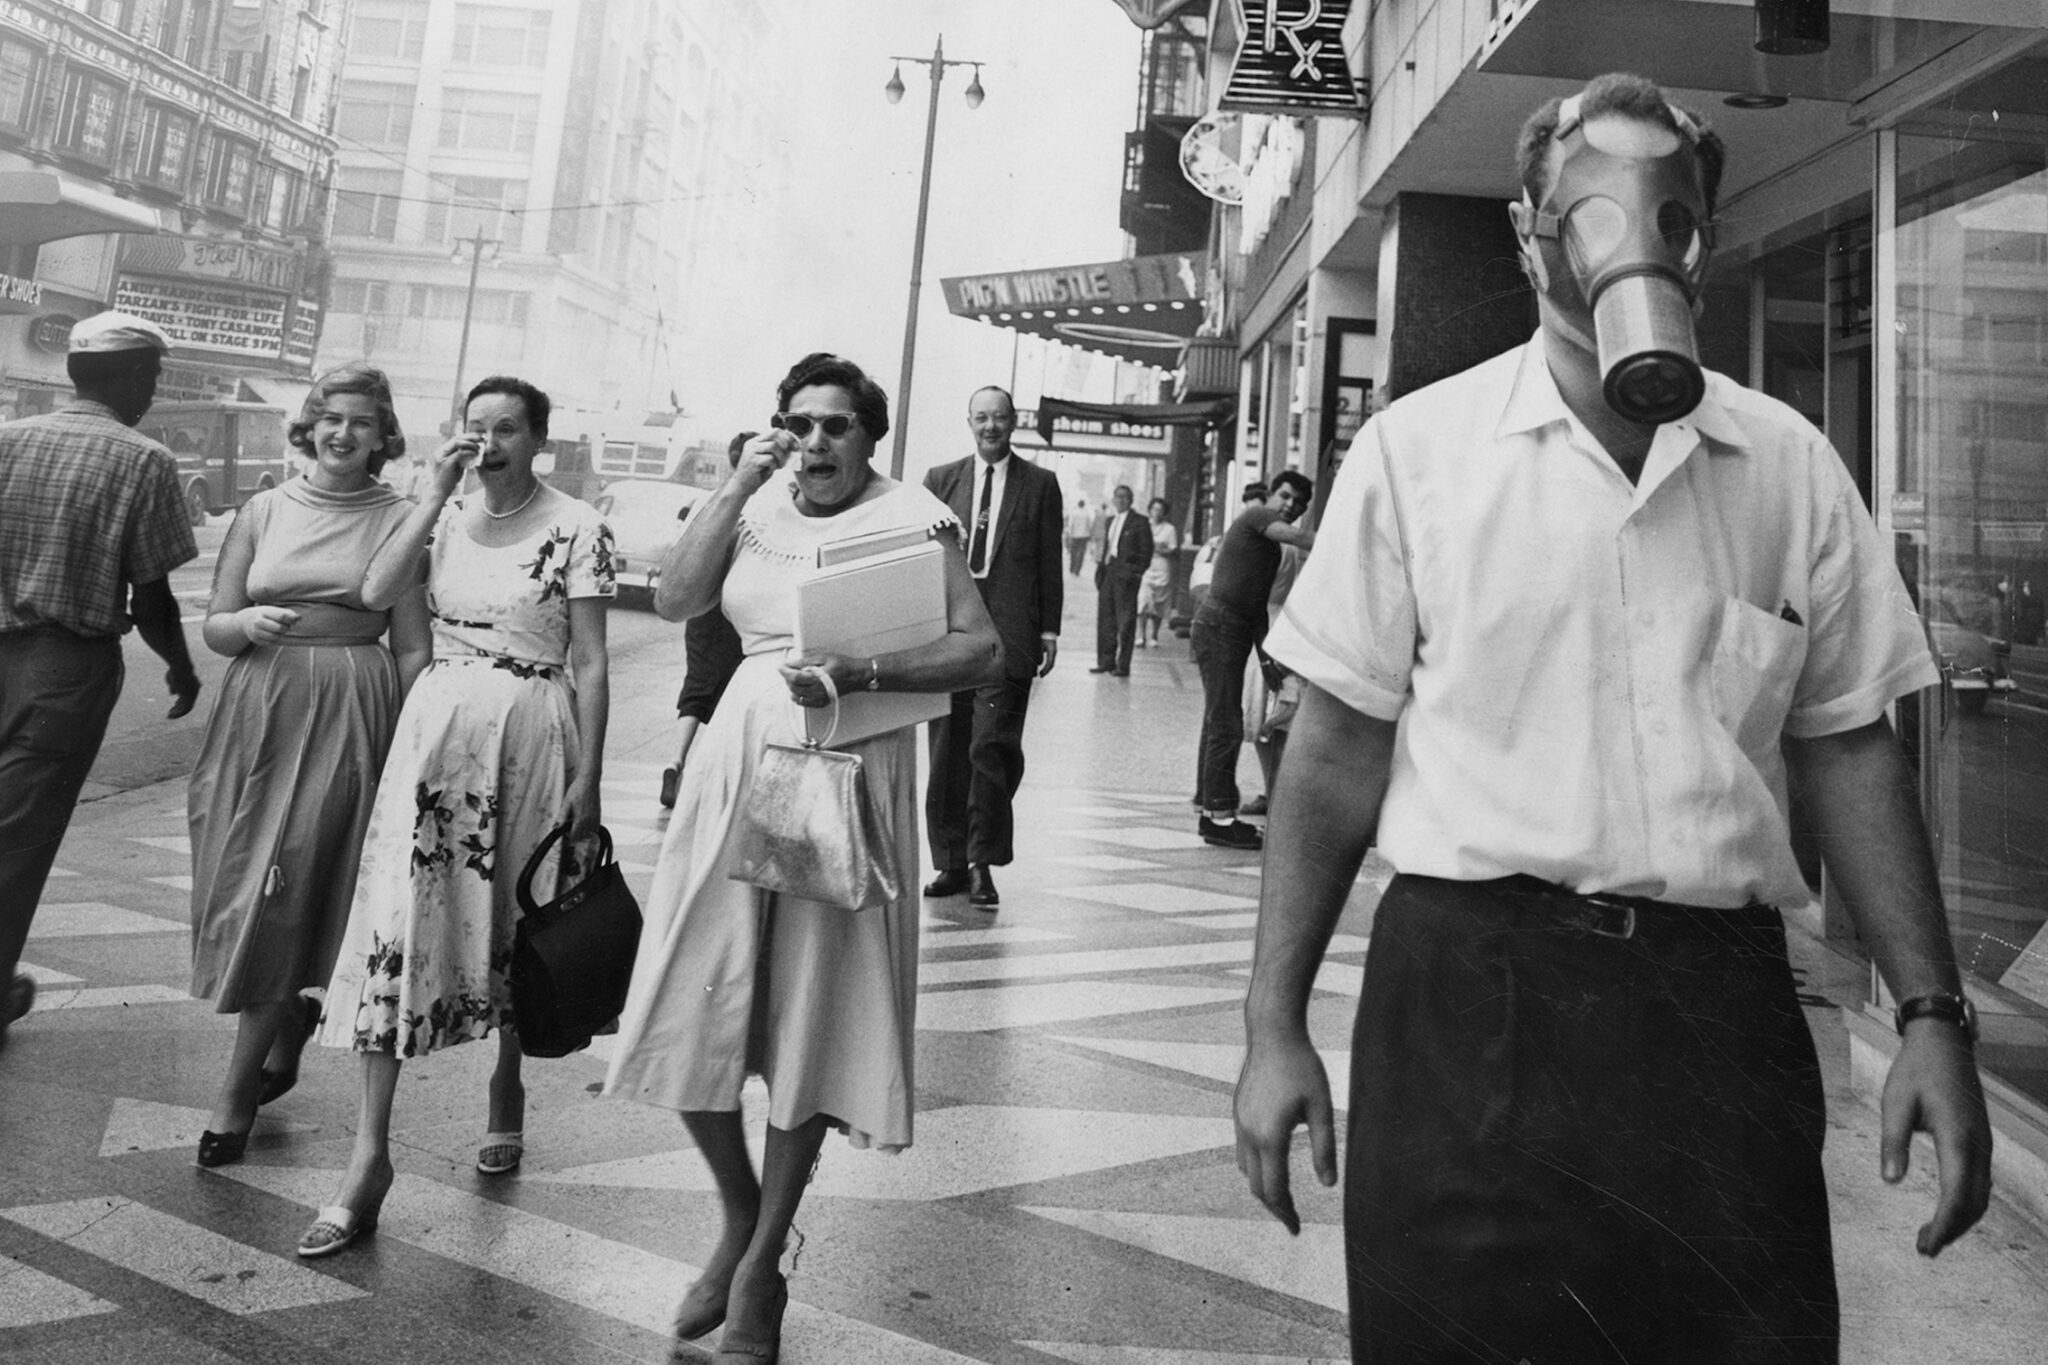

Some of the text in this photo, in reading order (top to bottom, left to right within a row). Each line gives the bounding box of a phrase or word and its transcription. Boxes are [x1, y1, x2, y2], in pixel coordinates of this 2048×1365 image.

[10, 277, 43, 306] SHOES
[118, 281, 283, 311] ANDY HARDY COMES HOME
[1012, 266, 1112, 305] WHISTLE
[117, 294, 180, 312] TARZAN'S
[185, 303, 219, 317] FIGHT
[224, 308, 248, 321] FOR
[254, 312, 279, 325] LIFE
[141, 310, 174, 325] DAVIS
[186, 316, 217, 331] TONY
[219, 320, 283, 338] CASANOVA
[191, 331, 208, 342] ON
[211, 333, 249, 348] STAGE
[1016, 410, 1163, 439] Flsheim shoes
